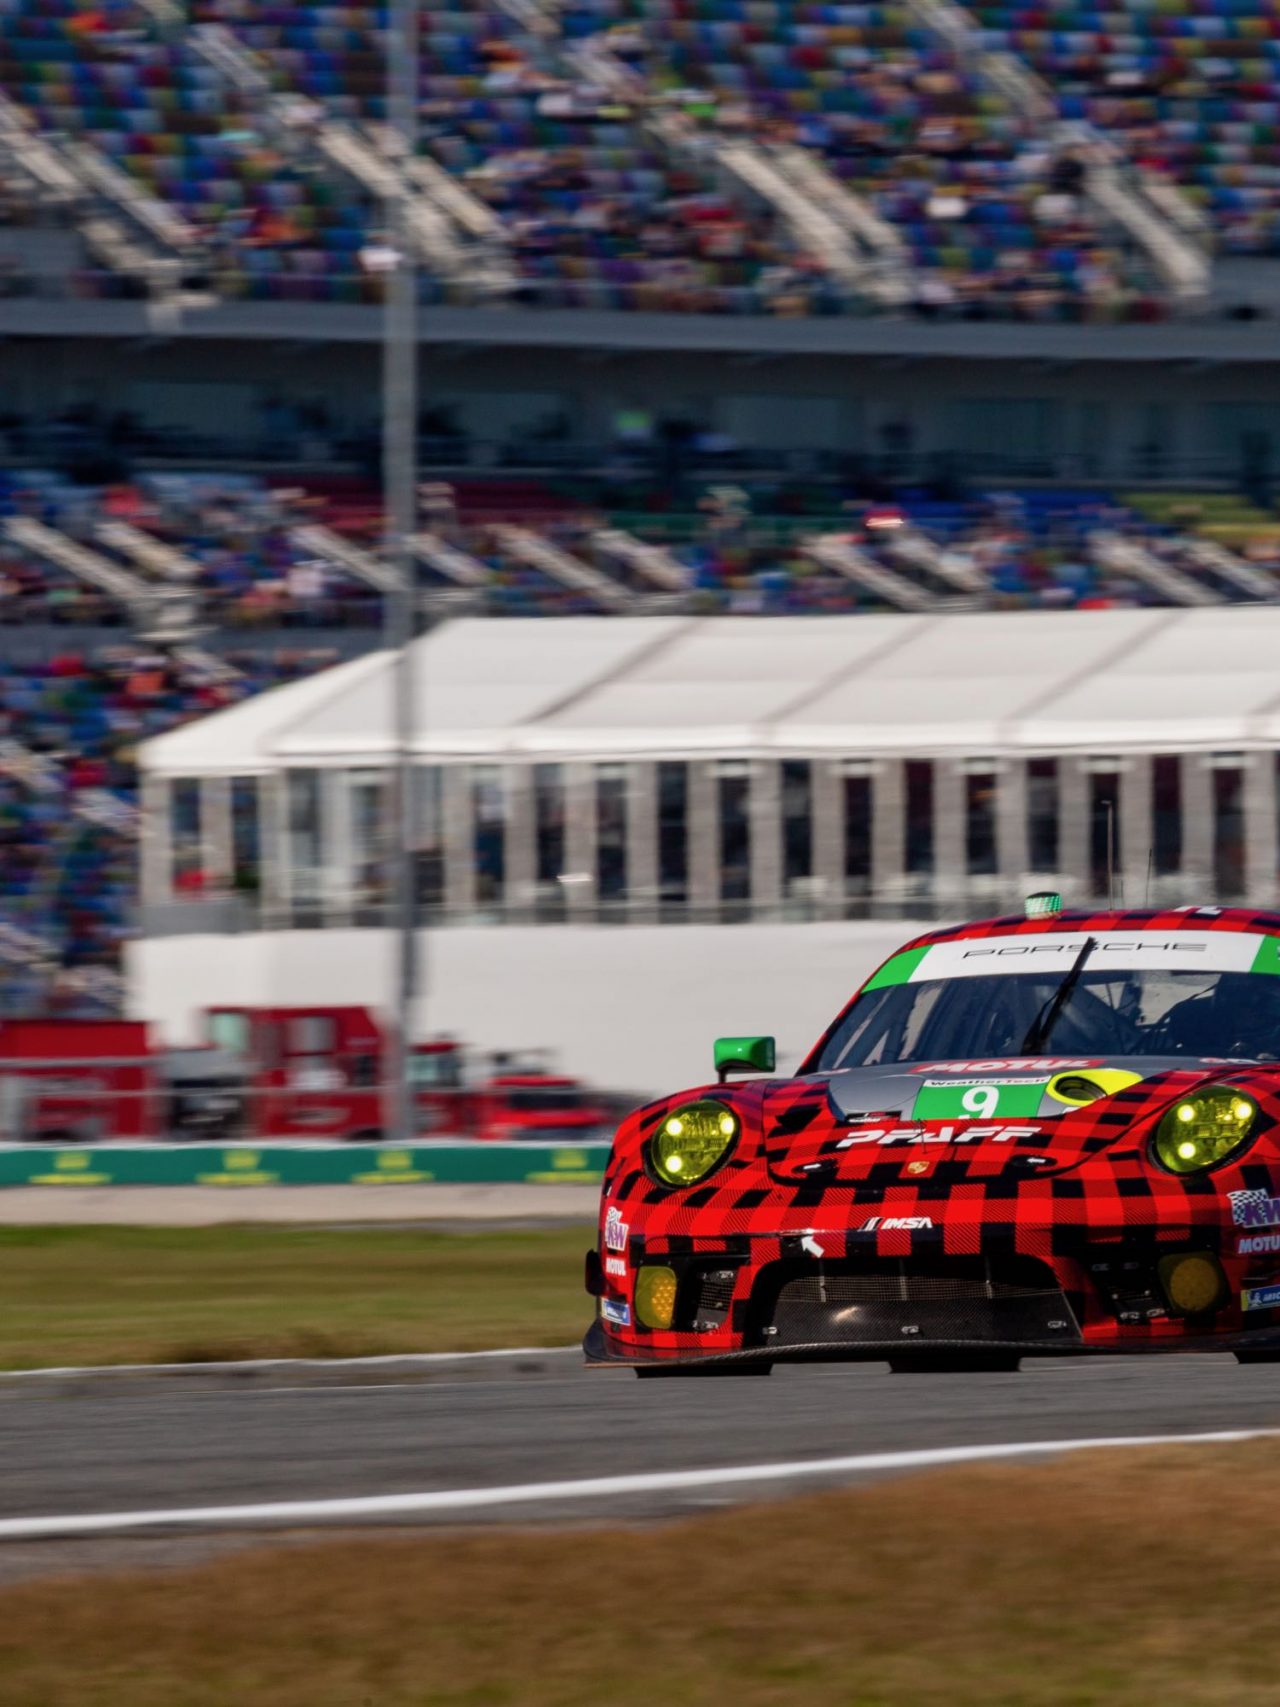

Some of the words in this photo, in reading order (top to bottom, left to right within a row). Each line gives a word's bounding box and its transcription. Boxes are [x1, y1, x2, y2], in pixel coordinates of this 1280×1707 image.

[963, 942, 1207, 959] PORSCHE
[918, 1059, 1091, 1072] MOTUL
[930, 1077, 1047, 1087] WeatherTech
[957, 1086, 1000, 1119] 9
[880, 1217, 933, 1230] IMSA
